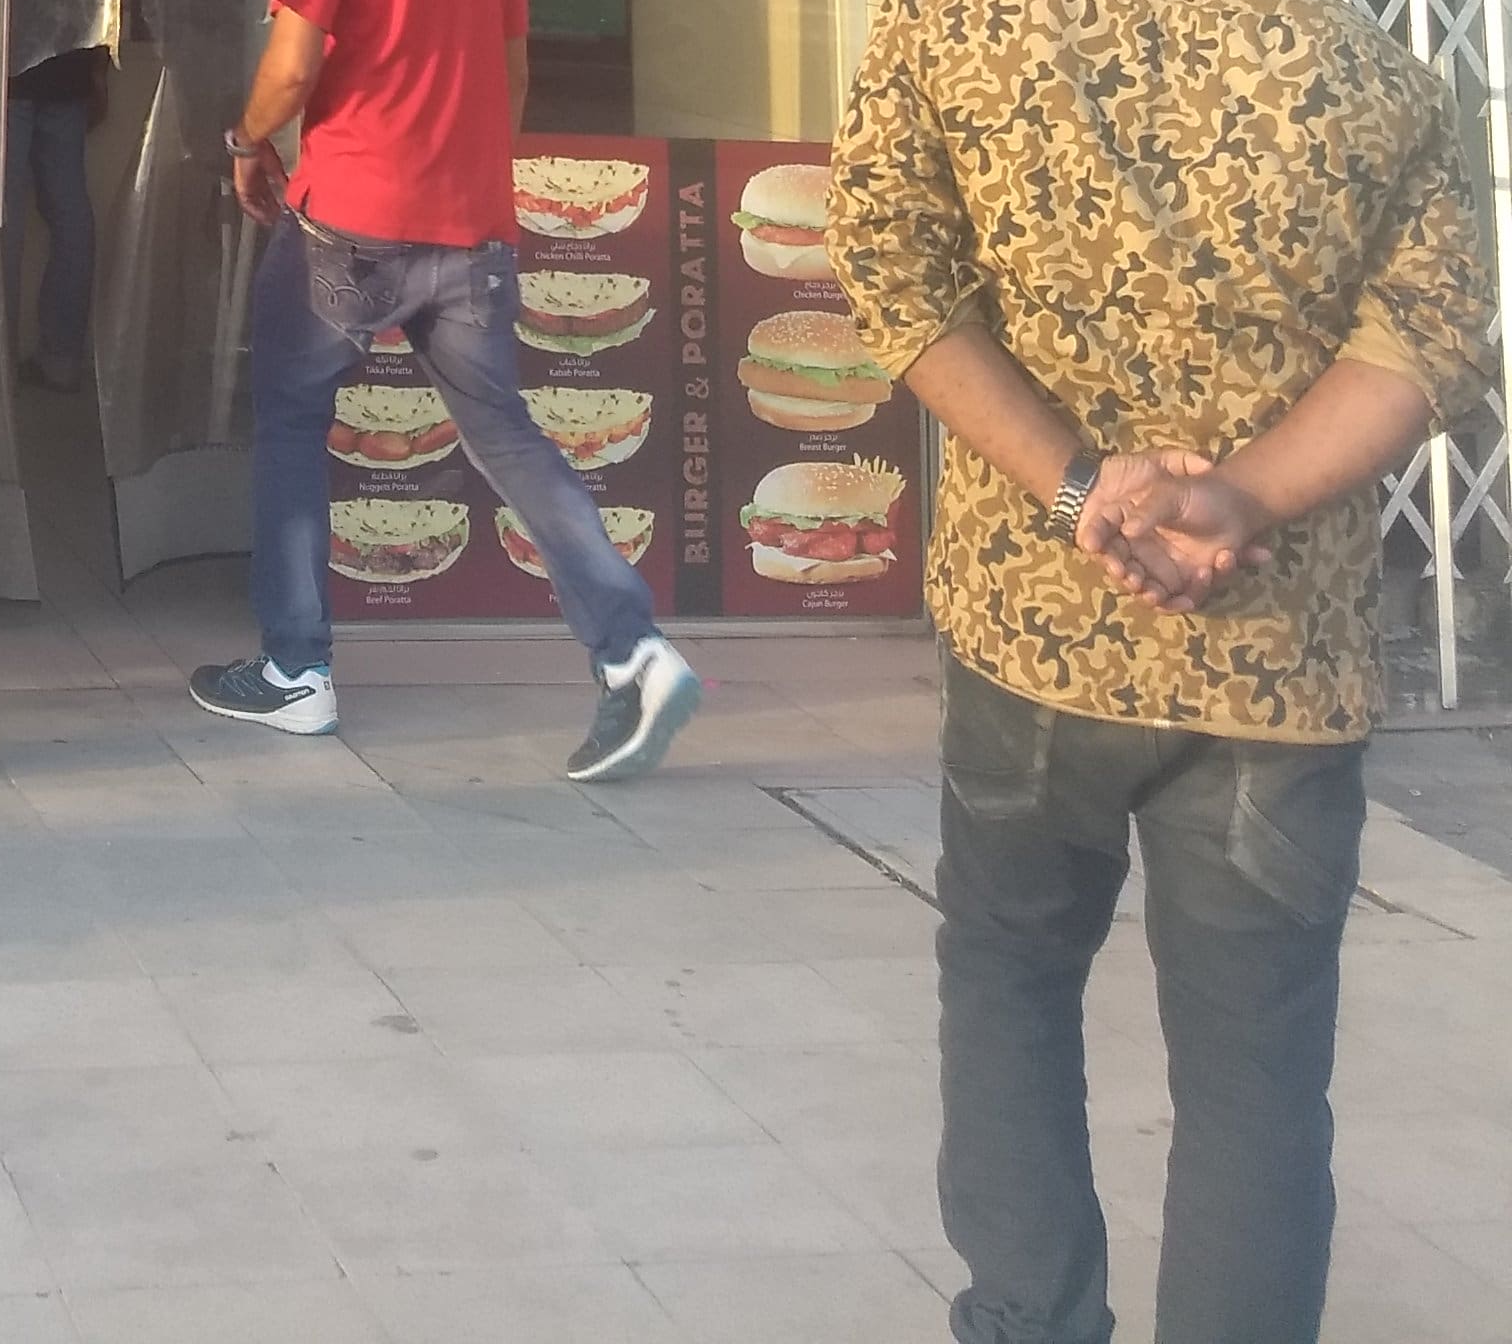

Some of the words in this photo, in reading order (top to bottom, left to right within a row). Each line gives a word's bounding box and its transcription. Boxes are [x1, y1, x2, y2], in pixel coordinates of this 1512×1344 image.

[535, 251, 564, 260] Chicken
[679, 181, 707, 365] PORATTA
[793, 290, 822, 299] Chicken
[823, 290, 845, 301] Burge
[685, 376, 710, 400] &
[799, 442, 822, 451] Breast
[822, 442, 847, 453] Burger
[683, 411, 710, 564] BURGER
[366, 594, 383, 604] Beef
[802, 599, 824, 609] Cajun
[824, 599, 848, 610] Burger
